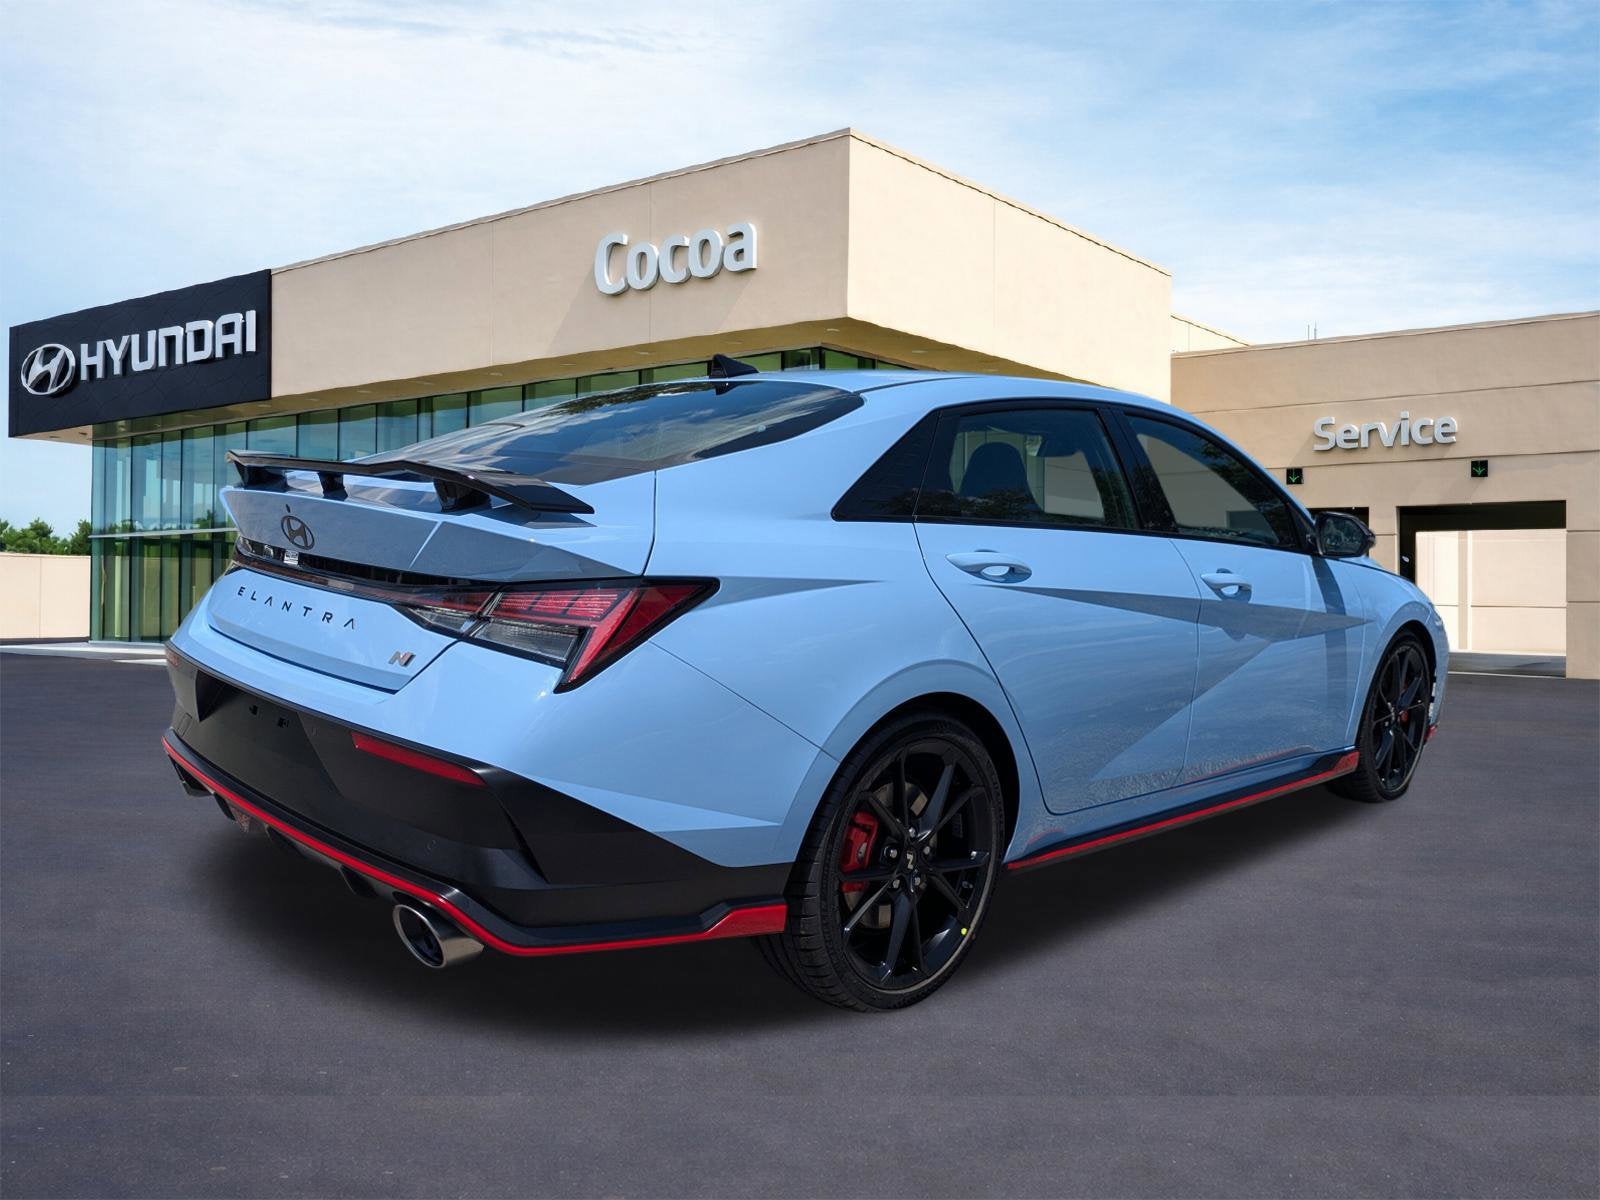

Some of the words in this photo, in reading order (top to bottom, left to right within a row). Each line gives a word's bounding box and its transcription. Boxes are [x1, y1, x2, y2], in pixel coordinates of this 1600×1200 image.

[594, 222, 757, 295] Cocoa
[80, 309, 256, 381] HYUNDAI
[1312, 410, 1458, 451] Service
[237, 586, 356, 630] ELANTRA
